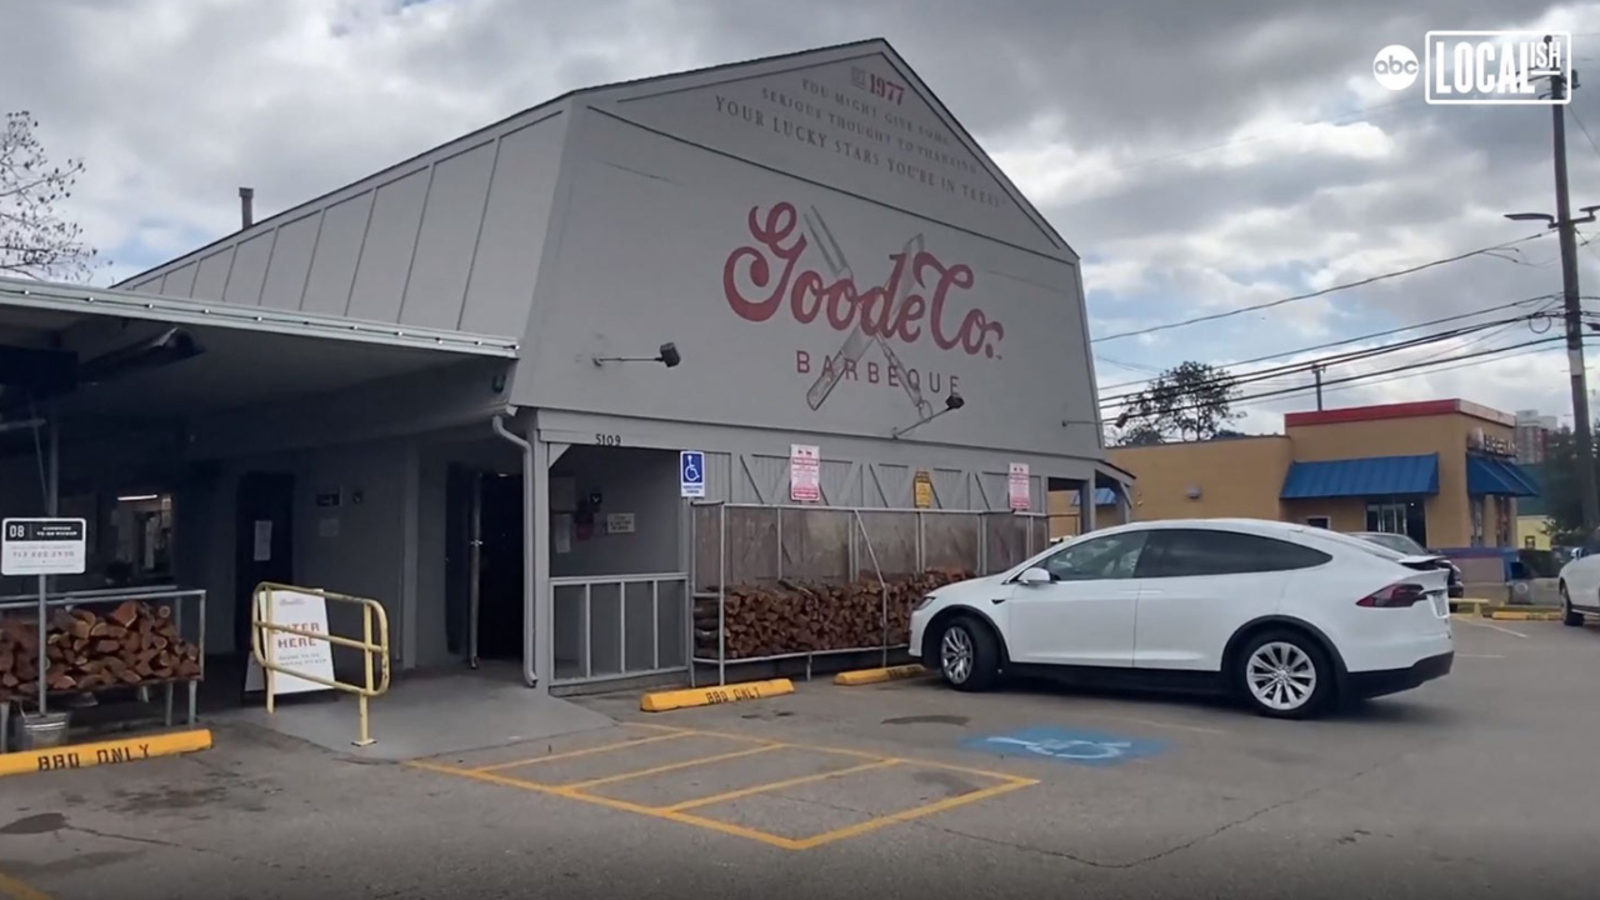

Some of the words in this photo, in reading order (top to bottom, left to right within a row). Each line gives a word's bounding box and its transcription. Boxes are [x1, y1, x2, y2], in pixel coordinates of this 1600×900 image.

[802, 78, 829, 98] YOU
[834, 92, 878, 118] MIGHT
[885, 113, 913, 133] GIVE
[870, 73, 905, 106] 1977
[762, 88, 822, 119] SERIOUS
[829, 113, 891, 145] THOUGHT
[898, 137, 914, 152] TO
[715, 95, 764, 127] YOUR
[773, 117, 827, 148] LUCKY
[835, 139, 880, 167] STARS
[941, 176, 956, 194] IN
[723, 201, 926, 343] Goode
[796, 350, 960, 397] BARBEQUE
[595, 434, 621, 446] 5109
[9, 525, 25, 537] 08
[278, 637, 317, 649] HERE
[97, 744, 150, 764] ONLY
